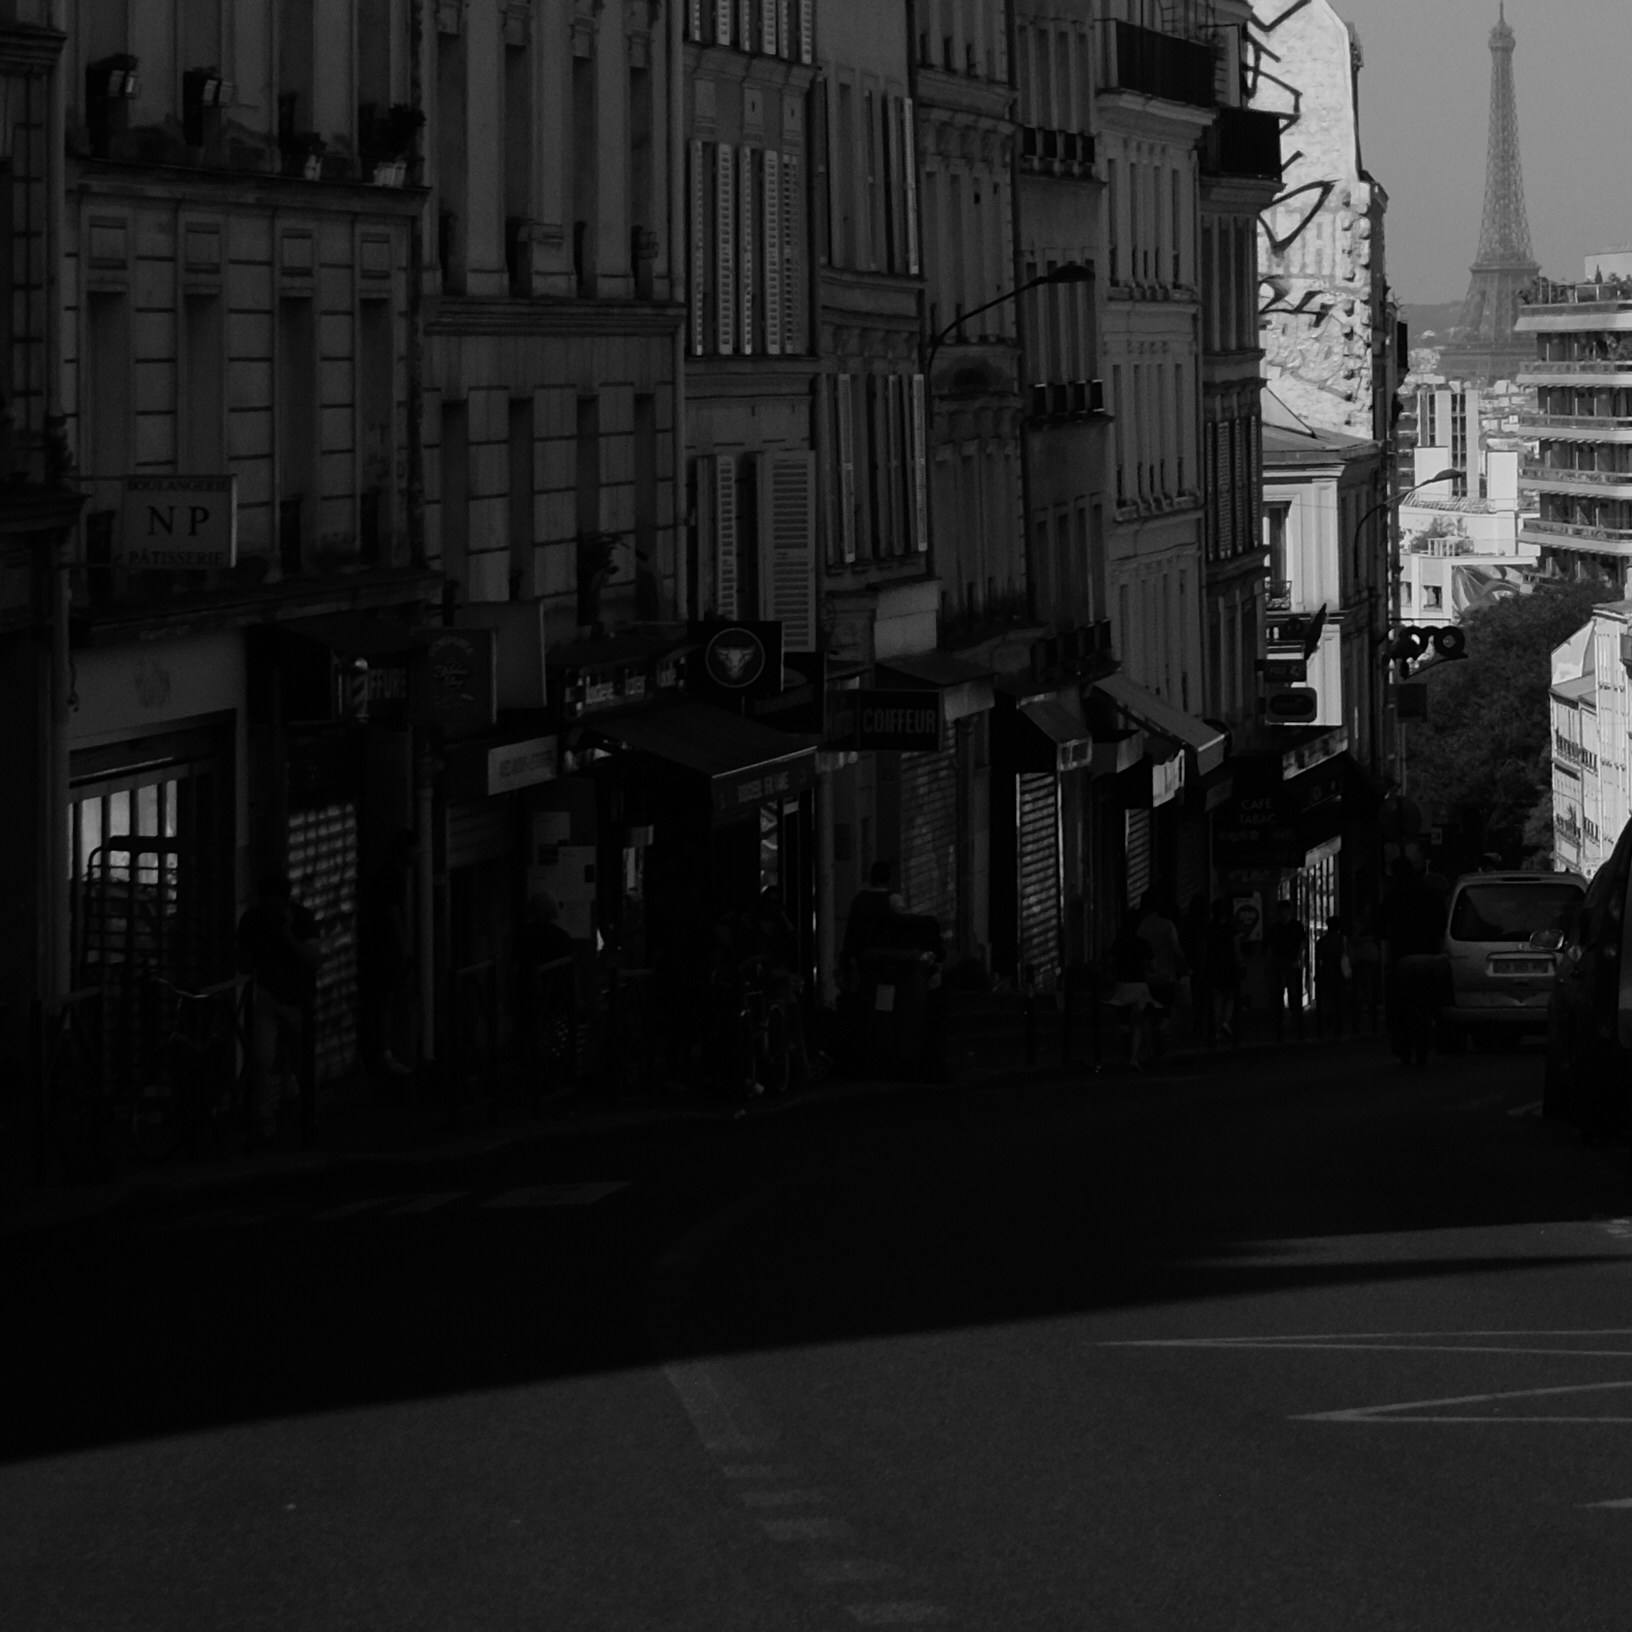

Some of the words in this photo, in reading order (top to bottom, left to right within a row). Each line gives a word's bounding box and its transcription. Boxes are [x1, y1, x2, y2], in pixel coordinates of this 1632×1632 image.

[127, 480, 231, 492] BOULANGERIE
[147, 505, 175, 535] N
[188, 506, 210, 536] P
[129, 548, 224, 566] PÂTISSERIE
[863, 708, 936, 735] COIFFEUR
